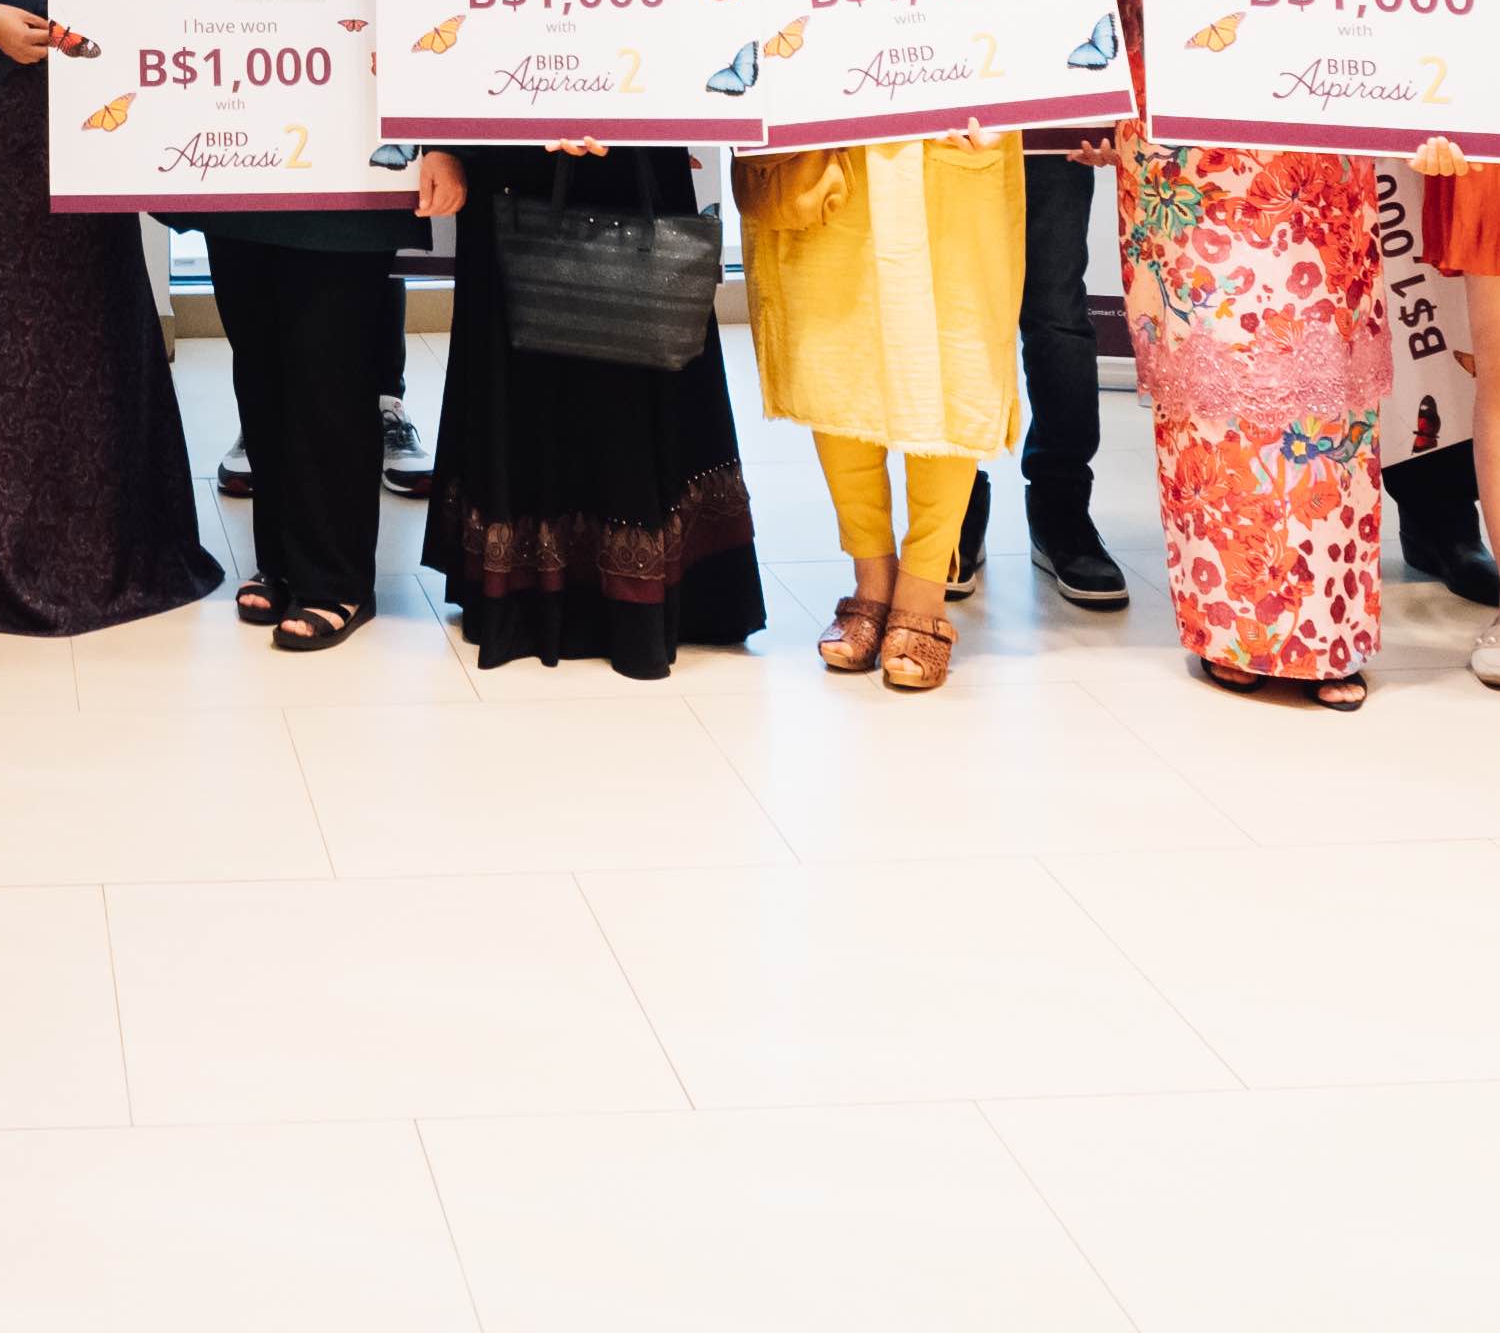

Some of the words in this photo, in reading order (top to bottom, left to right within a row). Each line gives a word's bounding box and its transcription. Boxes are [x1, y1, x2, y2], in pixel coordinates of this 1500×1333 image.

[182, 19, 189, 35] I
[194, 18, 235, 34] have
[240, 21, 277, 34] won
[893, 11, 927, 25] with
[545, 21, 576, 34] with
[1337, 24, 1372, 37] with
[536, 55, 579, 71] BIBD
[889, 45, 934, 65] BIBD
[139, 47, 331, 92] B$1,000
[842, 49, 973, 101] Aspirasi
[971, 31, 1004, 80] 2
[1328, 59, 1376, 76] BIBD
[487, 54, 614, 106] Aspirasi
[617, 47, 644, 94] 2
[1272, 58, 1416, 111] Aspirasi
[1420, 56, 1451, 104] 2
[214, 98, 245, 111] with
[206, 132, 248, 147] BIBD
[157, 132, 282, 182] Aspirasi
[284, 124, 311, 169] 2
